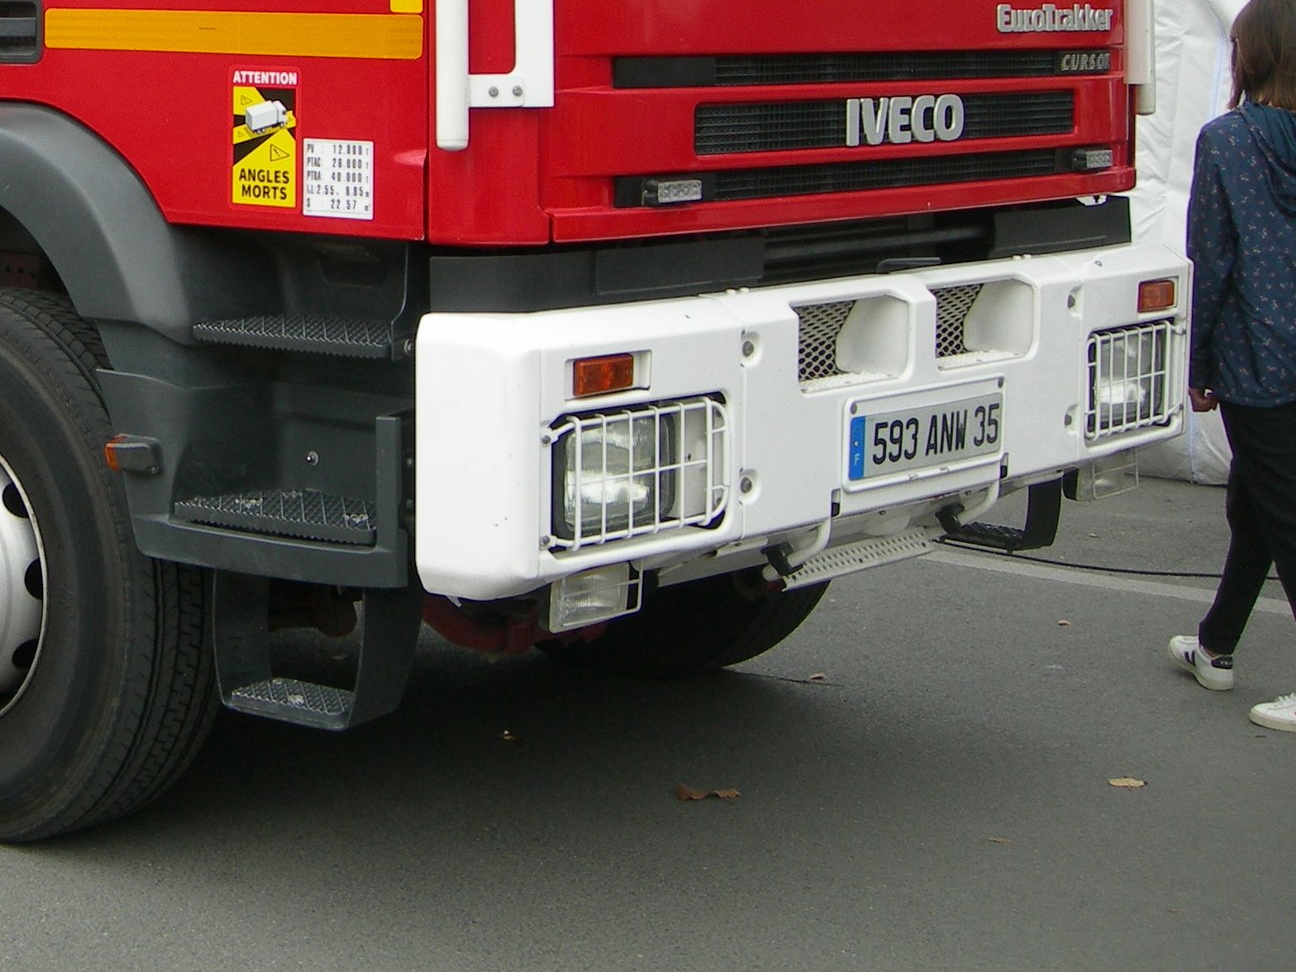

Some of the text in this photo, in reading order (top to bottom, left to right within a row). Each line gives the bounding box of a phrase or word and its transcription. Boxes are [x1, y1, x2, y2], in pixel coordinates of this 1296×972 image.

[997, 3, 1114, 33] EuroTrakker
[233, 70, 298, 85] ATTENTION
[846, 93, 966, 147] IVECO
[239, 167, 290, 184] ANGLES
[241, 185, 287, 200] MORTS
[872, 402, 1000, 465] 593 ANW 35
